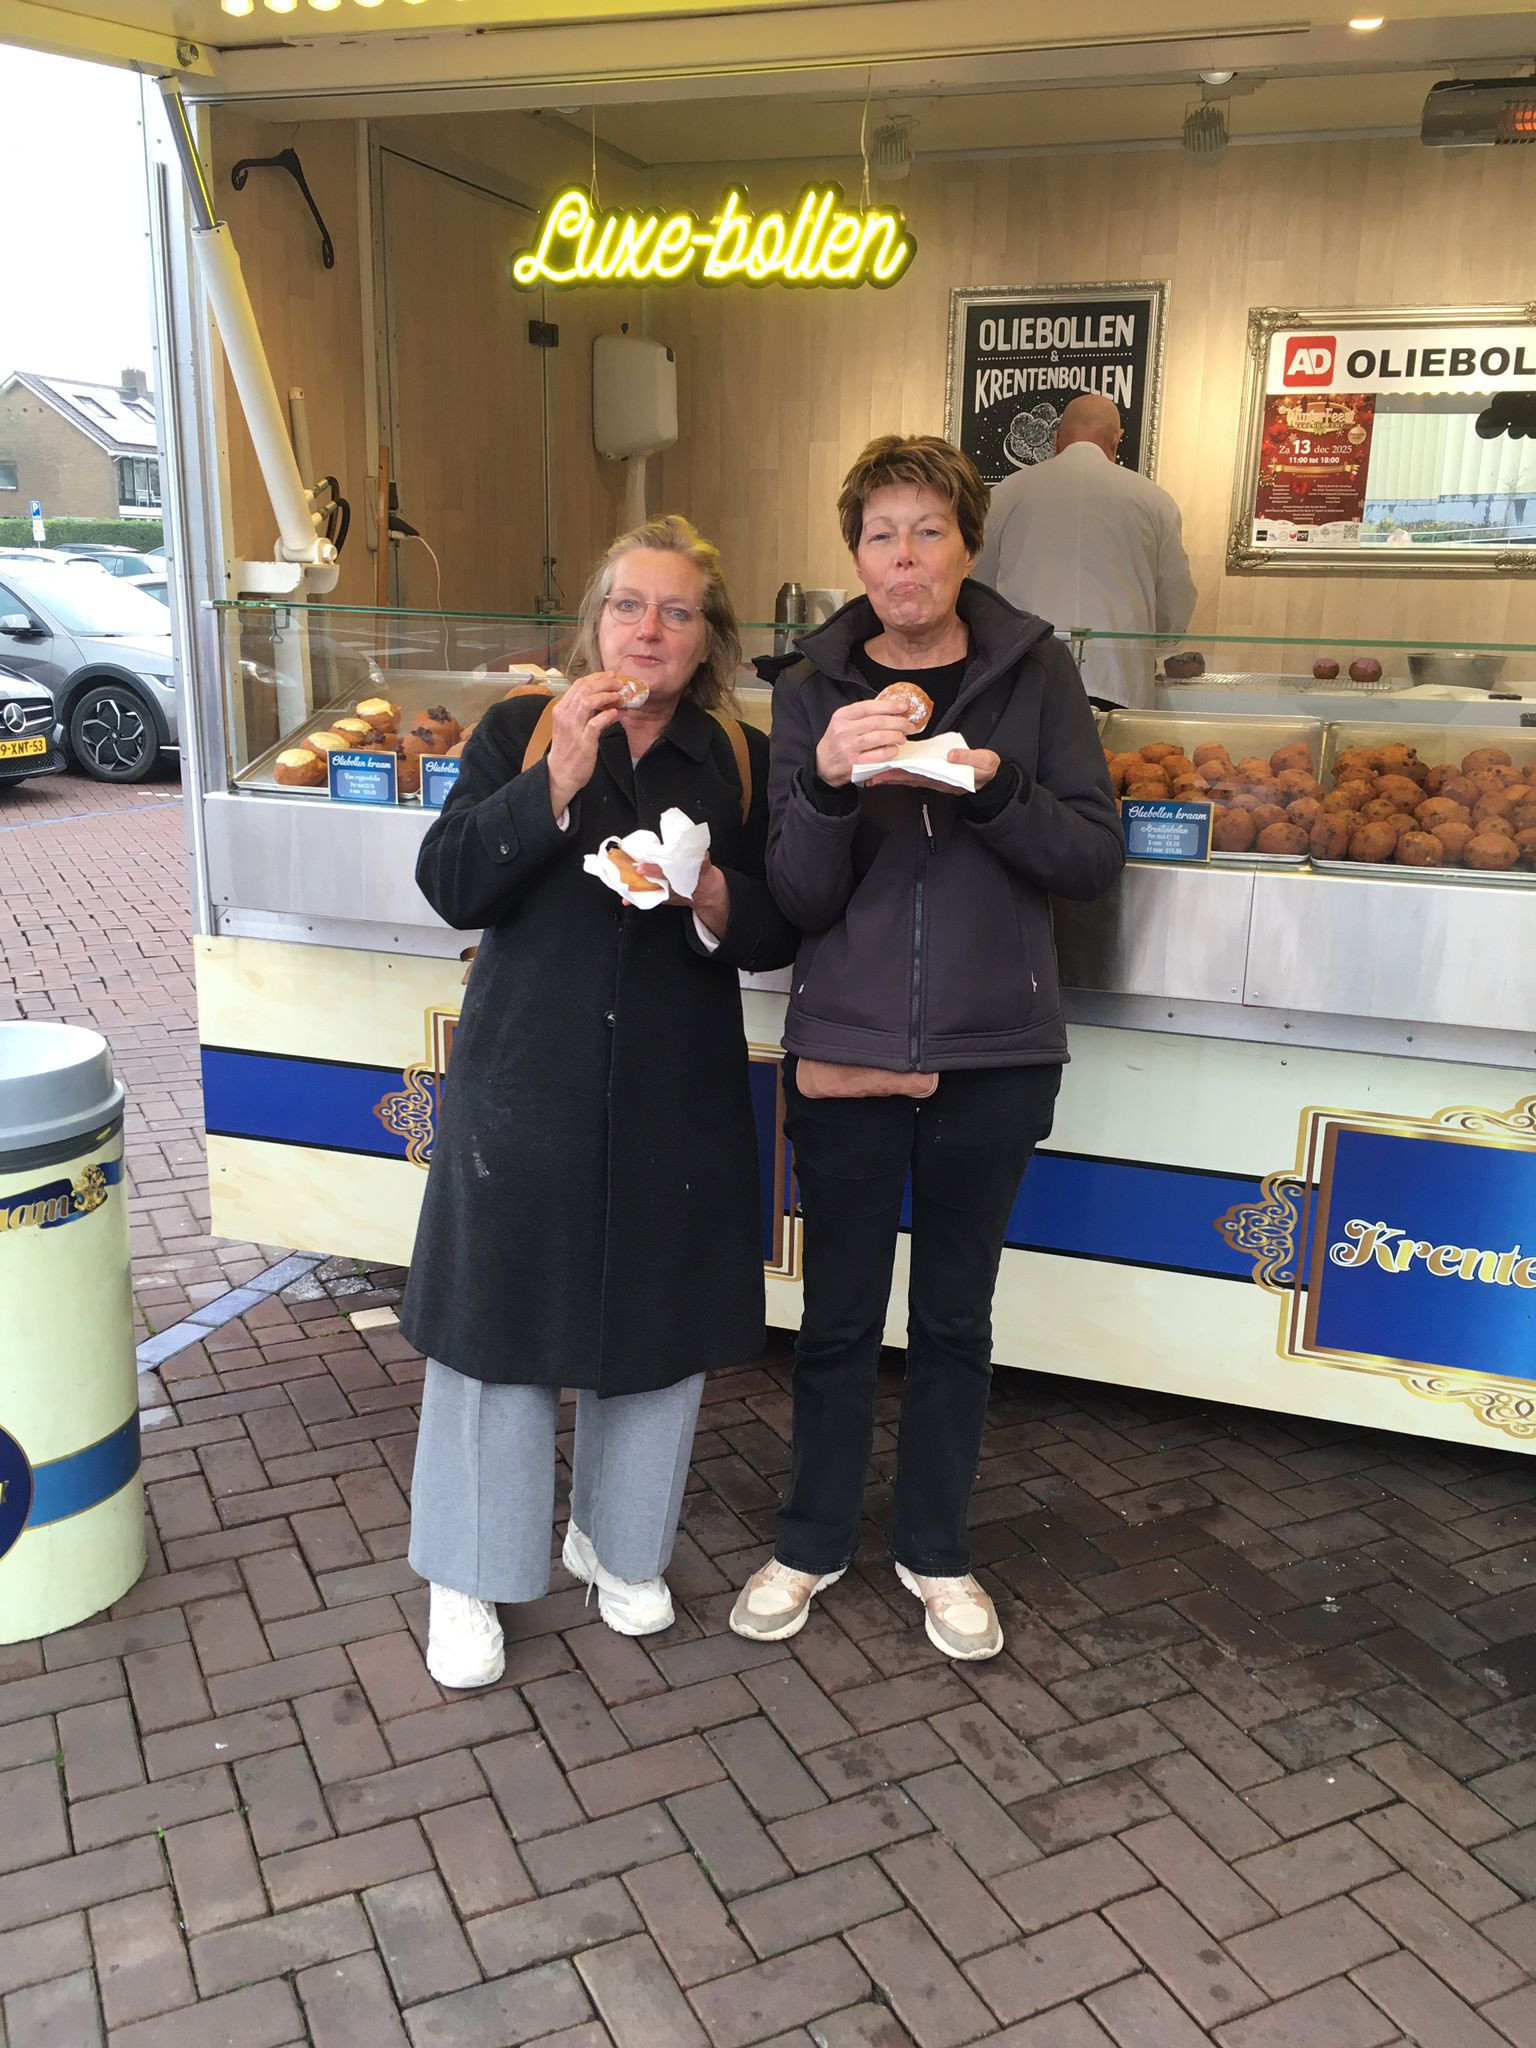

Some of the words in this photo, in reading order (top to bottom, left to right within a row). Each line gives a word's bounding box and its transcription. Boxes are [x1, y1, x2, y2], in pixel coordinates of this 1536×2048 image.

[513, 190, 907, 283] Luxe-bollen
[979, 315, 1135, 351] OLIEBOLLEN
[1050, 350, 1059, 362] &
[1287, 348, 1332, 375] AD
[1346, 346, 1536, 379] OLIEBOL
[975, 364, 1133, 414] KRENTENBOLLEN
[1279, 445, 1291, 454] Za
[1293, 439, 1311, 454] 13
[1313, 445, 1329, 454] dec
[1332, 445, 1352, 454] 2025
[1289, 456, 1308, 464] 11:00
[1309, 456, 1319, 464] tot
[1320, 456, 1340, 464] 18:00
[0, 740, 43, 756] 9-XNT-53
[367, 757, 391, 769] kraam
[1128, 805, 1173, 819] Oliebollen
[1175, 808, 1207, 821] kraam
[1329, 1218, 1536, 1289] Krente
